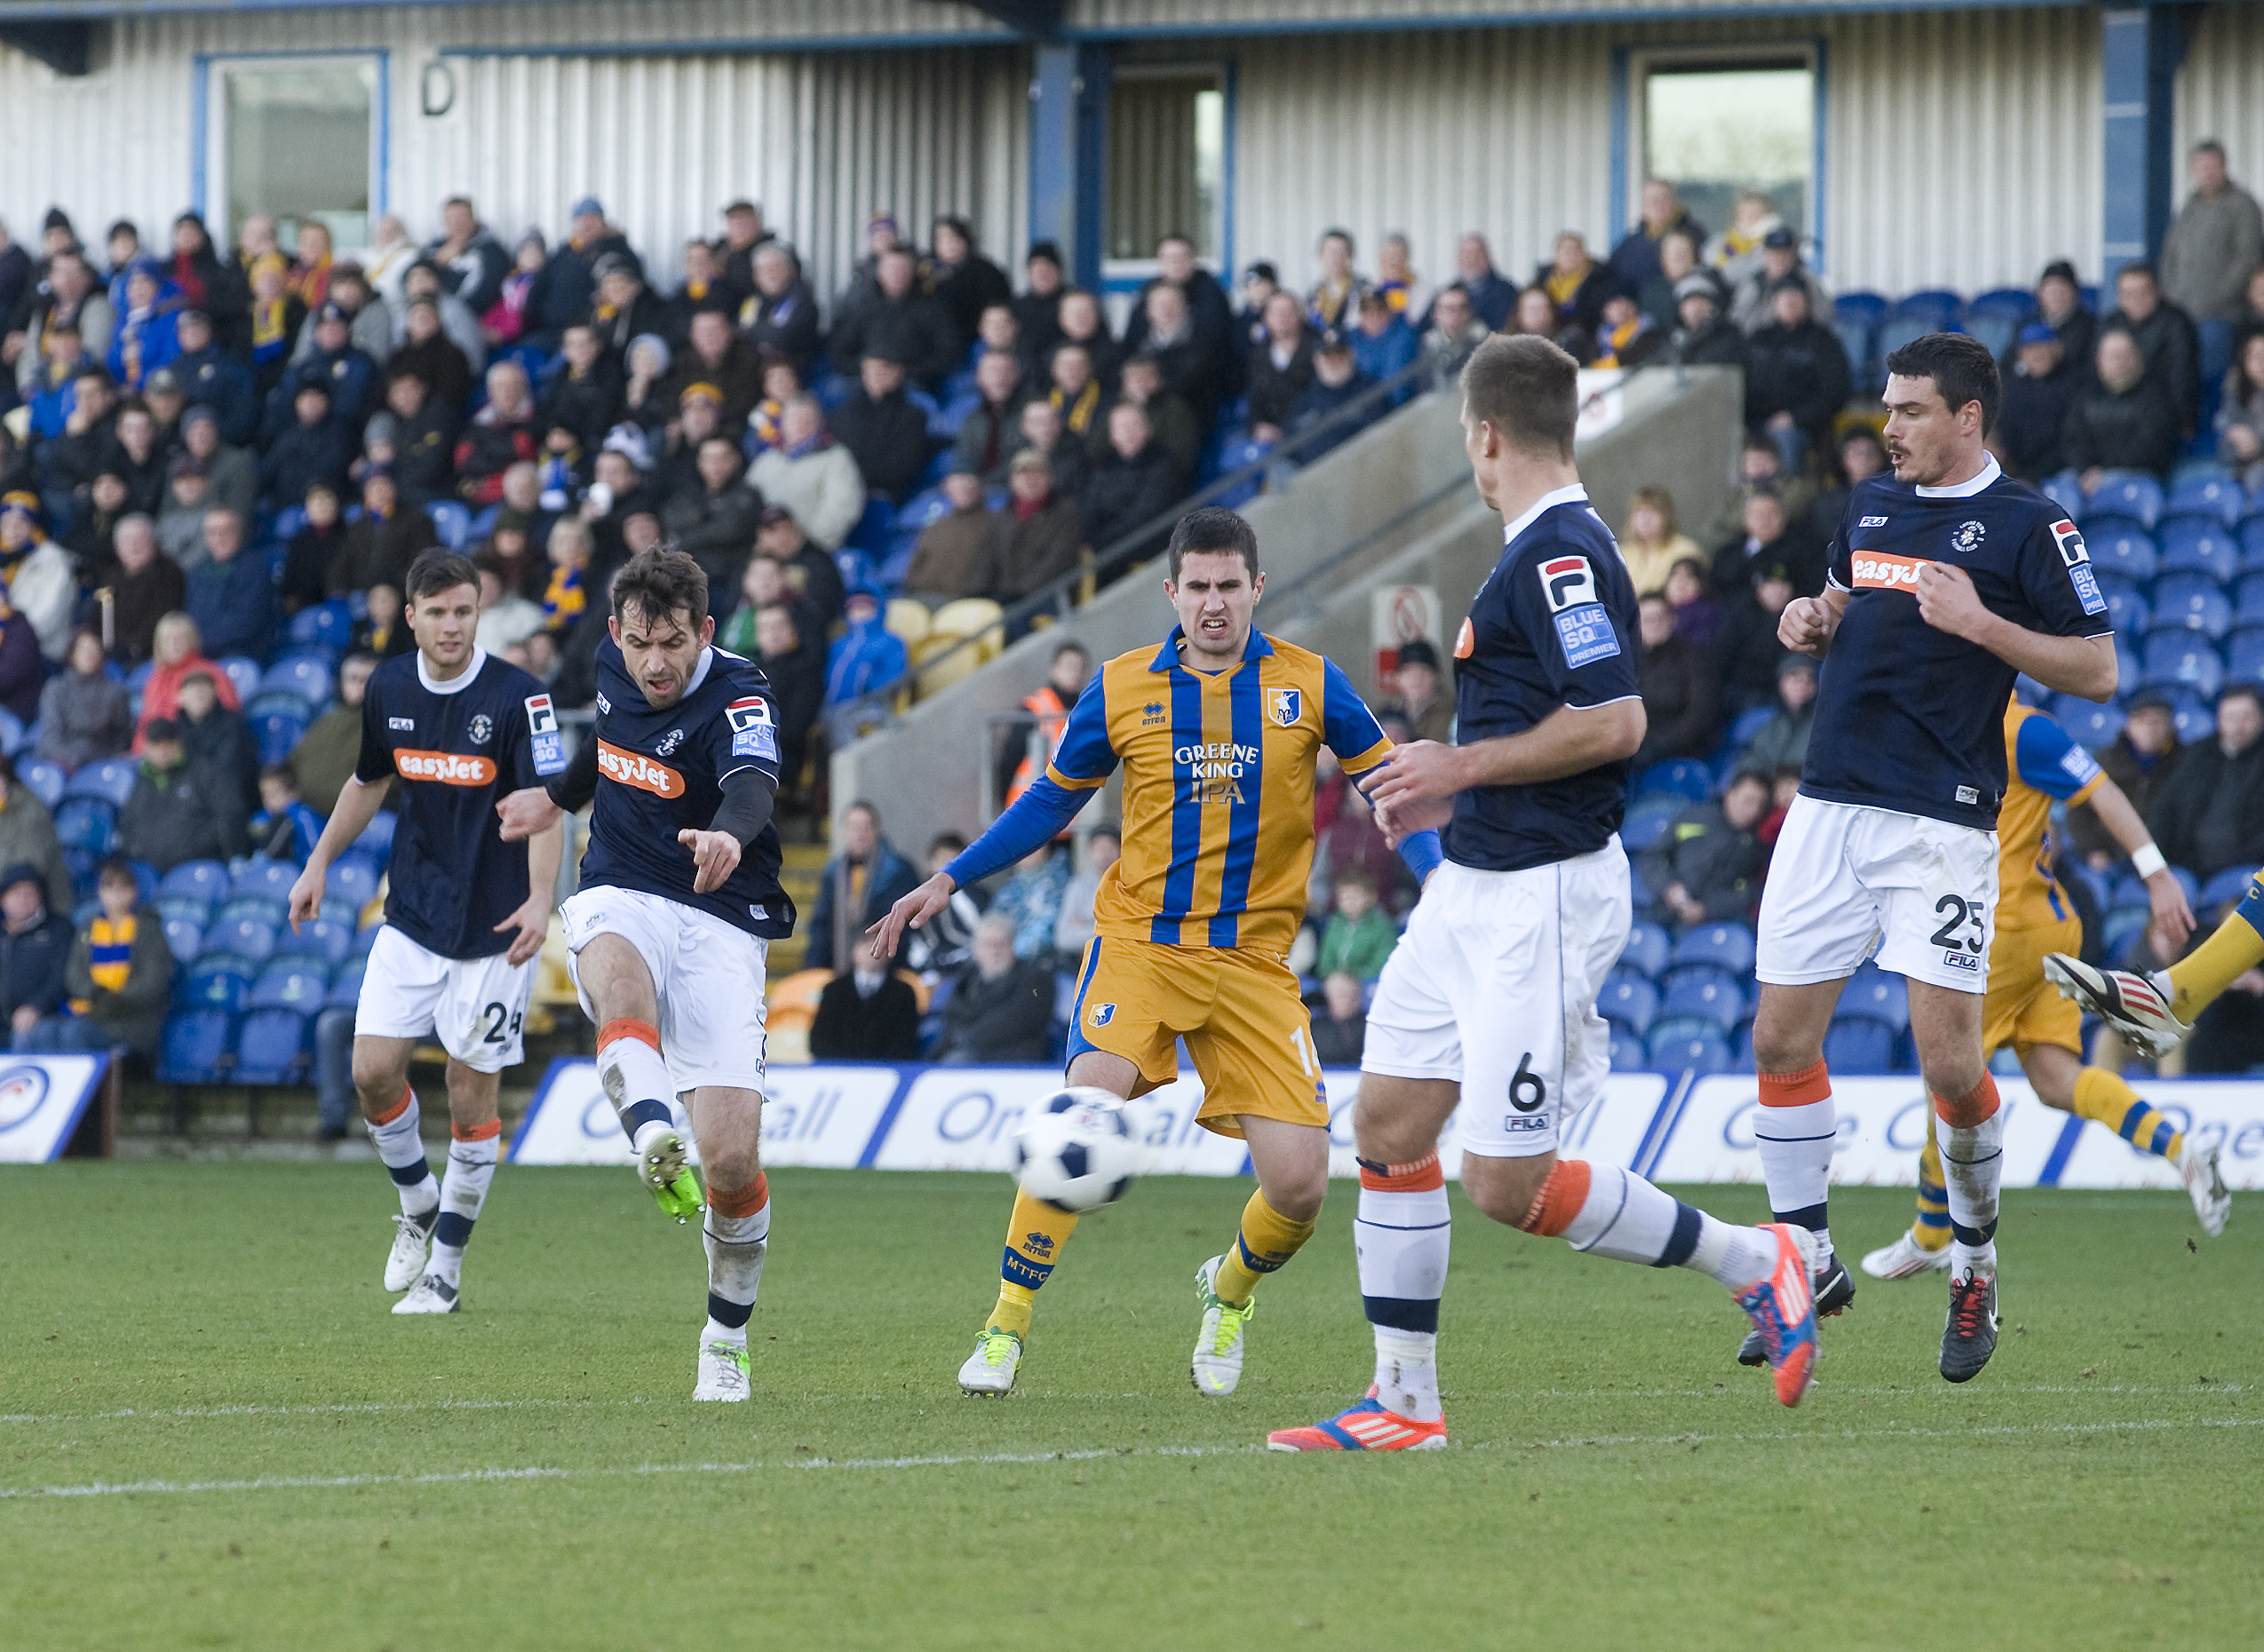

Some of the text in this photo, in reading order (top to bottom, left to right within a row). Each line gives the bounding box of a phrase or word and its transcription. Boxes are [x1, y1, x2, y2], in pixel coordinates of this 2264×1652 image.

[422, 60, 456, 116] D
[1862, 517, 1884, 527] FILA
[1855, 560, 1927, 586] easyJ
[1560, 608, 1604, 633] BLUE
[1565, 626, 1596, 649] SQ
[1570, 642, 1617, 663] PREMIER
[1174, 743, 1259, 765] GREENE
[400, 755, 484, 781] easyJet
[598, 748, 671, 791] asyJet
[1192, 762, 1243, 779] KING
[1190, 781, 1246, 805] IPA
[1930, 894, 1985, 954] 25
[1949, 953, 1977, 969] FILA
[1508, 1052, 1546, 1113] 6
[1511, 1117, 1545, 1131] FILA
[1005, 1255, 1049, 1283] MTFC
